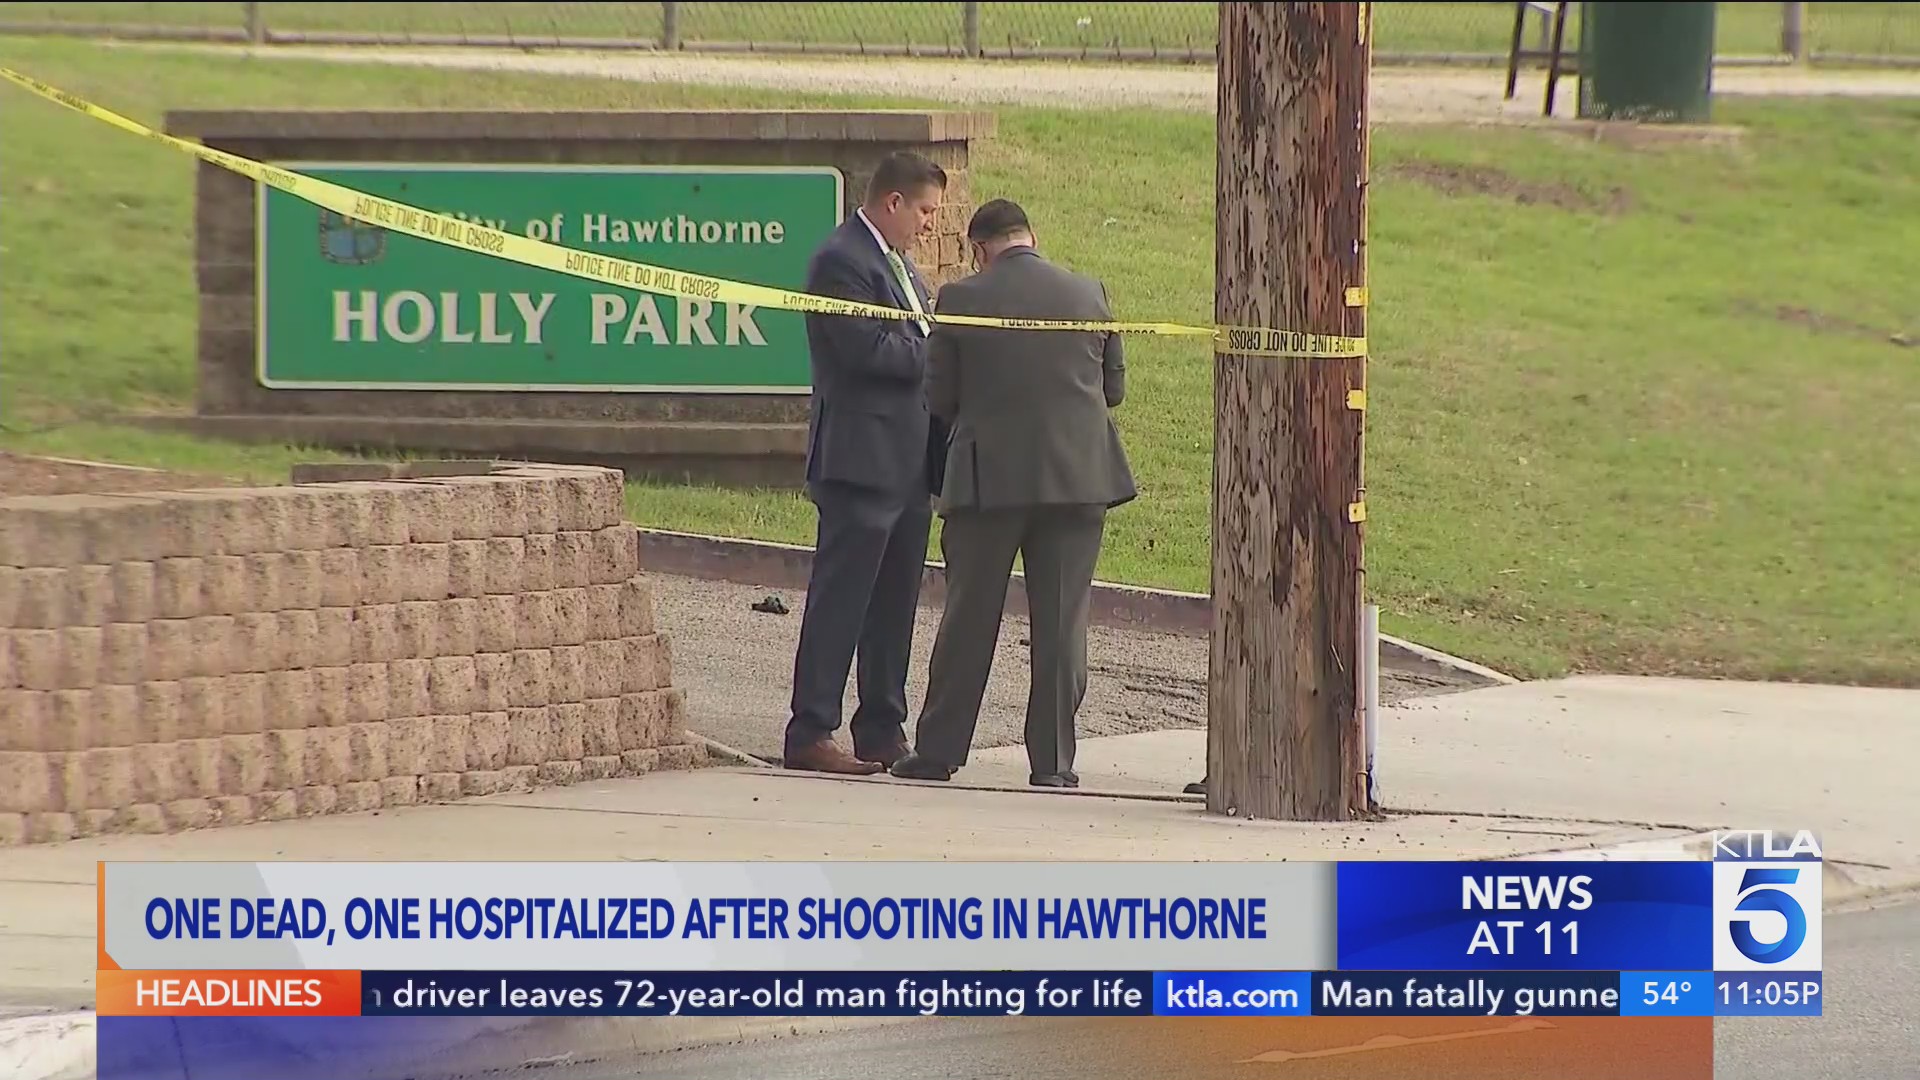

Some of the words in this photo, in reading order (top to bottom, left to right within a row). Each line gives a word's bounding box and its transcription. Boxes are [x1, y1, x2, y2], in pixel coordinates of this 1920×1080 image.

[526, 213, 564, 242] of
[583, 213, 785, 244] Hawthorne
[332, 290, 557, 344] HOLLY
[590, 293, 768, 345] PARK
[1229, 330, 1261, 350] CROSS
[1264, 332, 1288, 351] NOT
[1292, 332, 1307, 351] DO
